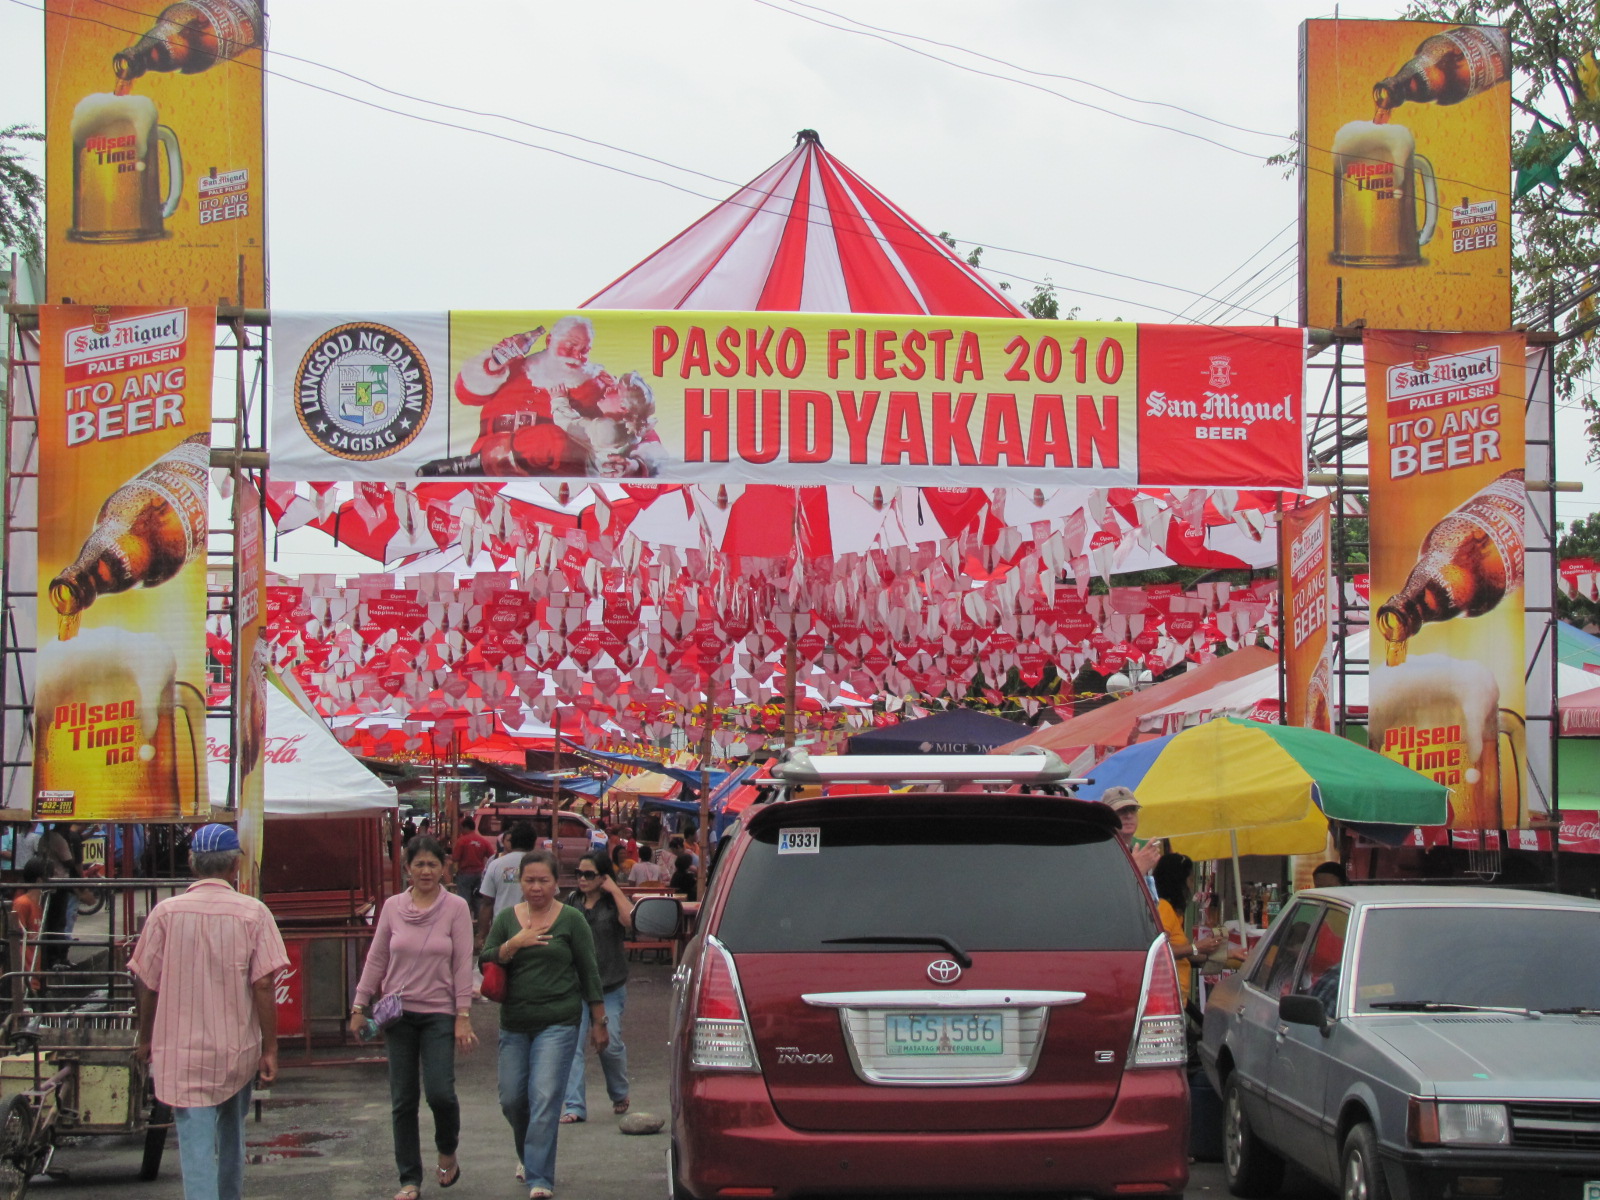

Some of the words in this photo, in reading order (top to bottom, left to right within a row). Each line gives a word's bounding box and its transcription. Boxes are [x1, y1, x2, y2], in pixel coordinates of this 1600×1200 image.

[86, 134, 136, 152] Pilsen
[96, 150, 136, 165] Time
[118, 162, 136, 174] na
[1346, 162, 1394, 178] Pilsen
[1354, 176, 1394, 191] Time
[200, 198, 219, 210] ITO
[222, 192, 248, 206] ANG
[200, 203, 248, 224] BEER
[1452, 227, 1470, 240] ITO
[1474, 224, 1496, 235] ANG
[1453, 234, 1496, 253] BEER
[74, 334, 110, 354] San
[112, 316, 178, 348] Miguel
[88, 357, 124, 375] PALE
[129, 348, 180, 368] PILSEN
[651, 325, 807, 380] PASKO
[826, 328, 984, 384] FIESTA
[1002, 335, 1124, 384] 2010
[302, 334, 352, 414] LUNGSOD
[359, 332, 385, 354] NG
[388, 344, 423, 412] DABAW
[1395, 370, 1430, 390] San
[1430, 356, 1493, 386] Miguel
[66, 382, 114, 411] ITO
[122, 368, 185, 399] ANG
[1409, 394, 1444, 411] PALE
[1448, 384, 1494, 402] PILSEN
[67, 394, 185, 446] BEER
[1146, 390, 1198, 418] San
[1200, 390, 1294, 425] Miguel
[683, 388, 1120, 468] HUDYAKAAN
[1195, 426, 1247, 440] BEER
[1388, 419, 1436, 445] ITO
[1442, 404, 1499, 432] ANG
[330, 430, 397, 451] SAGISAG
[1390, 430, 1500, 480] BEER
[1293, 588, 1305, 618] ITO
[1307, 568, 1325, 603] ANG
[1294, 594, 1326, 650] BEER
[54, 700, 136, 730] Pilsen
[68, 724, 135, 751] Time
[1384, 724, 1461, 752] Pilsen
[105, 746, 135, 766] na
[1398, 748, 1460, 771] Time
[1432, 769, 1460, 786] na
[789, 834, 818, 848] 9331
[894, 1018, 938, 1043] LGS
[952, 1018, 994, 1042] 586
[778, 1054, 833, 1064] INNOVA
